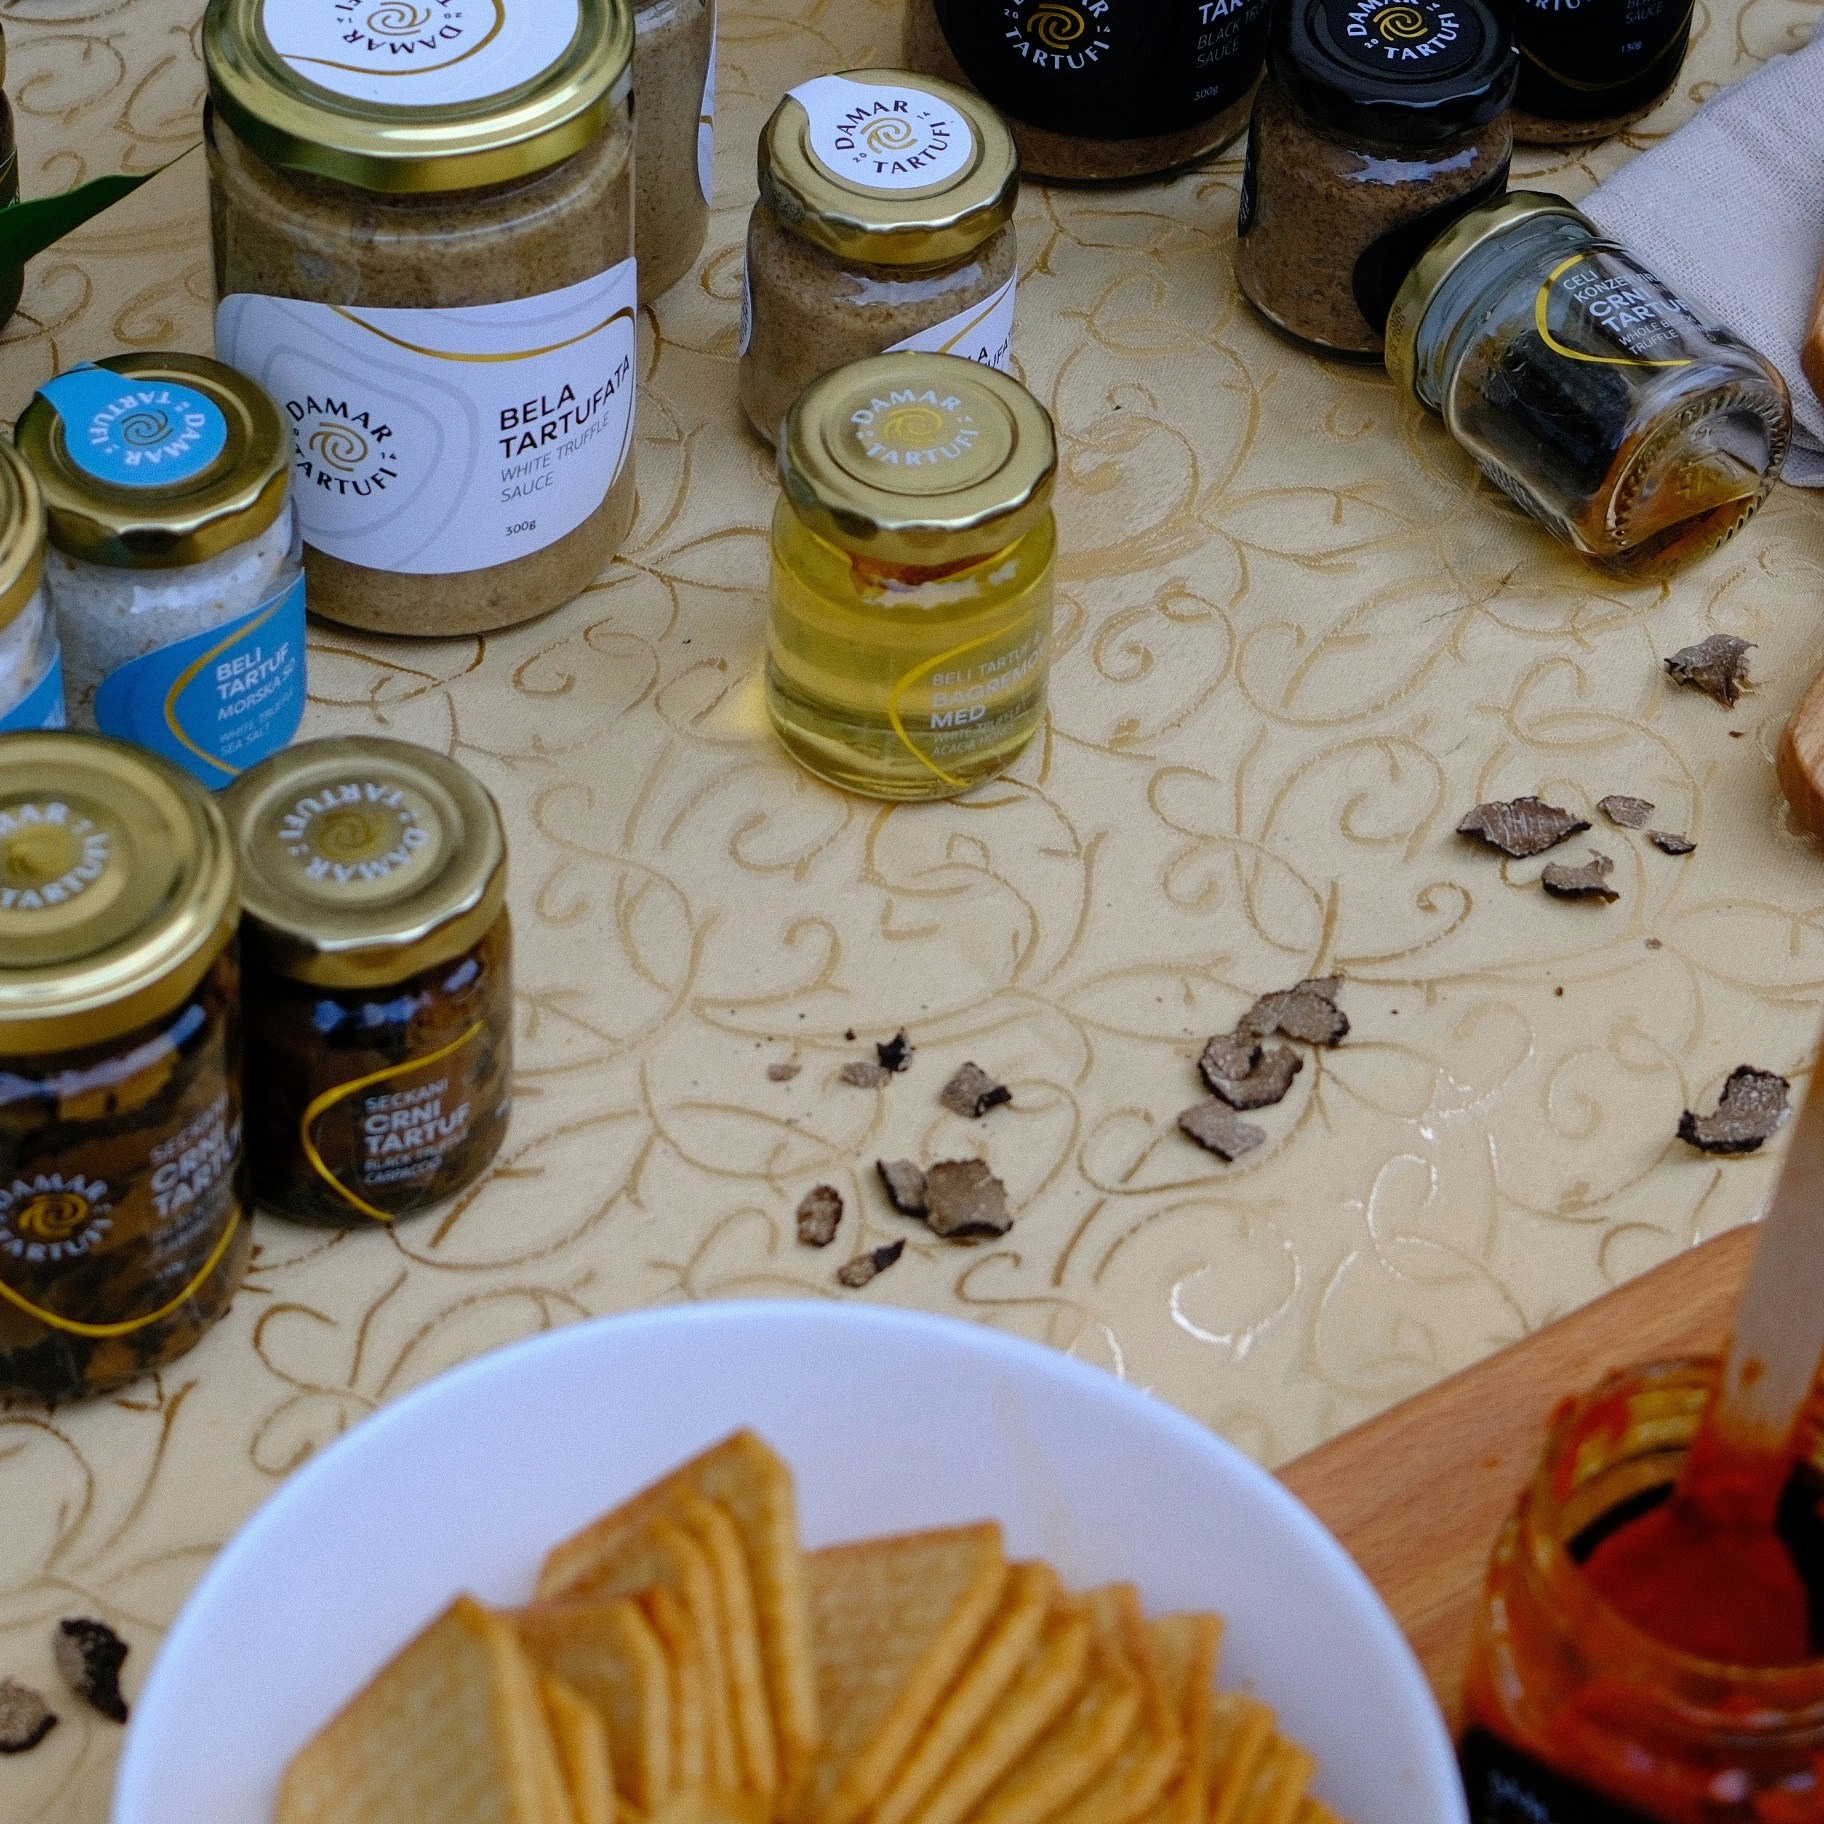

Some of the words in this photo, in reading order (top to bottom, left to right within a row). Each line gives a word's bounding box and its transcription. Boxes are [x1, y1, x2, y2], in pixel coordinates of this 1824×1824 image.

[342, 24, 464, 56] DAMAR
[1003, 26, 1111, 72] TARTUFI
[1196, 37, 1240, 69] SAUCE
[1197, 17, 1241, 50] BLACK
[1383, 11, 1462, 62] TARTUFI
[834, 99, 909, 151] DAMAR
[872, 119, 952, 175] TARTUFI
[1562, 270, 1599, 292] CELI
[1588, 286, 1654, 318] CRNI
[1617, 321, 1658, 347] WHOLE
[1628, 329, 1679, 356] TRUFFLE
[86, 388, 174, 447] TARTUFI
[285, 394, 393, 443] DAMAR
[498, 354, 632, 461] TARTUFATA
[499, 384, 577, 432] BELA
[850, 389, 962, 427] DAMAR
[121, 408, 208, 468] DAMAR
[500, 452, 553, 483] WHITE
[555, 411, 610, 456] TRUFFLE
[866, 429, 979, 468] TARTUFI
[294, 442, 398, 497] TARTUFI
[500, 472, 555, 504] SAUCE
[504, 520, 538, 537] 300g
[214, 646, 264, 683] BELI
[214, 640, 293, 701] TARTUF
[214, 675, 282, 724] MORSKA
[930, 704, 989, 730] MED
